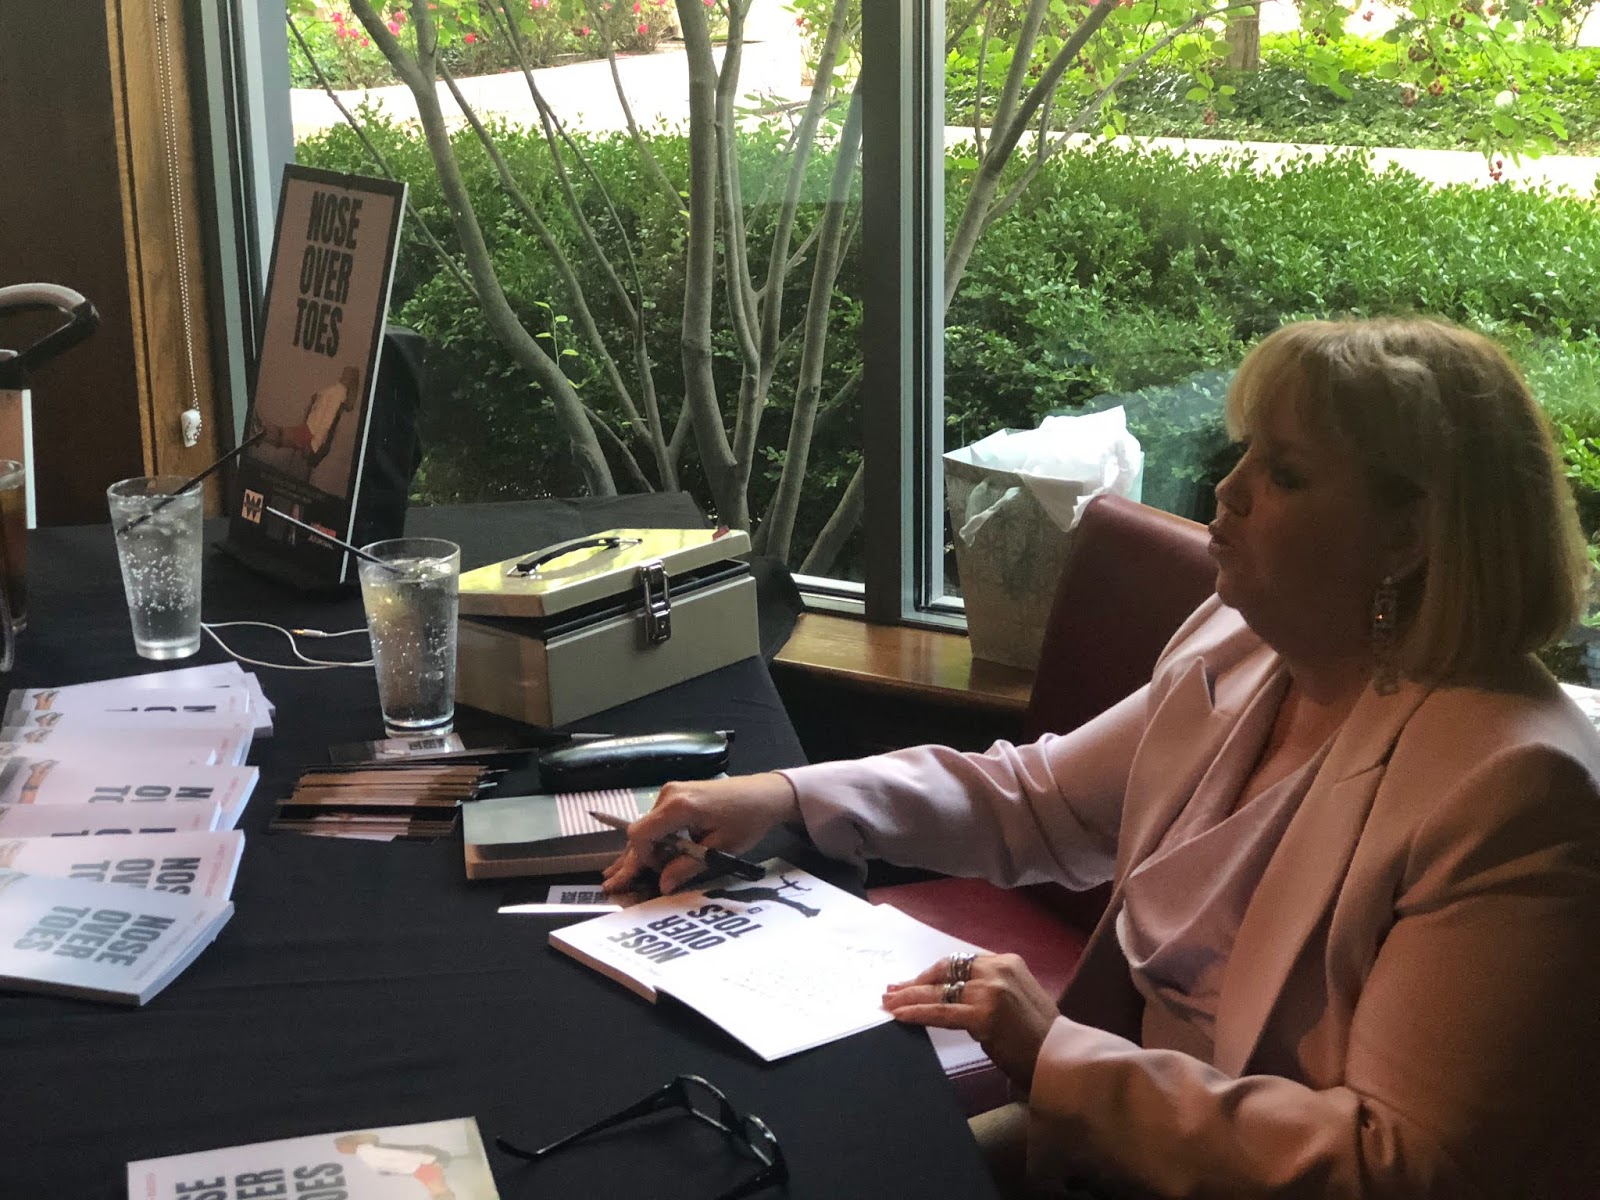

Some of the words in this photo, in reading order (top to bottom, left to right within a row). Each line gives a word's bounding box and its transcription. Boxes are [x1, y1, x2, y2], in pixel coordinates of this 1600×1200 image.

[306, 190, 363, 250] NOSE
[300, 244, 353, 304] OVER
[292, 297, 343, 358] TOES
[110, 858, 155, 889] OV
[153, 857, 201, 895] NOS
[14, 906, 92, 952] TOES
[53, 909, 132, 960] OVER
[647, 915, 726, 950] OVER
[687, 904, 763, 938] TOES
[94, 914, 176, 967] NOSE
[607, 927, 690, 964] NOSE
[175, 1175, 227, 1200] SE
[235, 1168, 287, 1200] ER
[293, 1162, 349, 1200] OES
